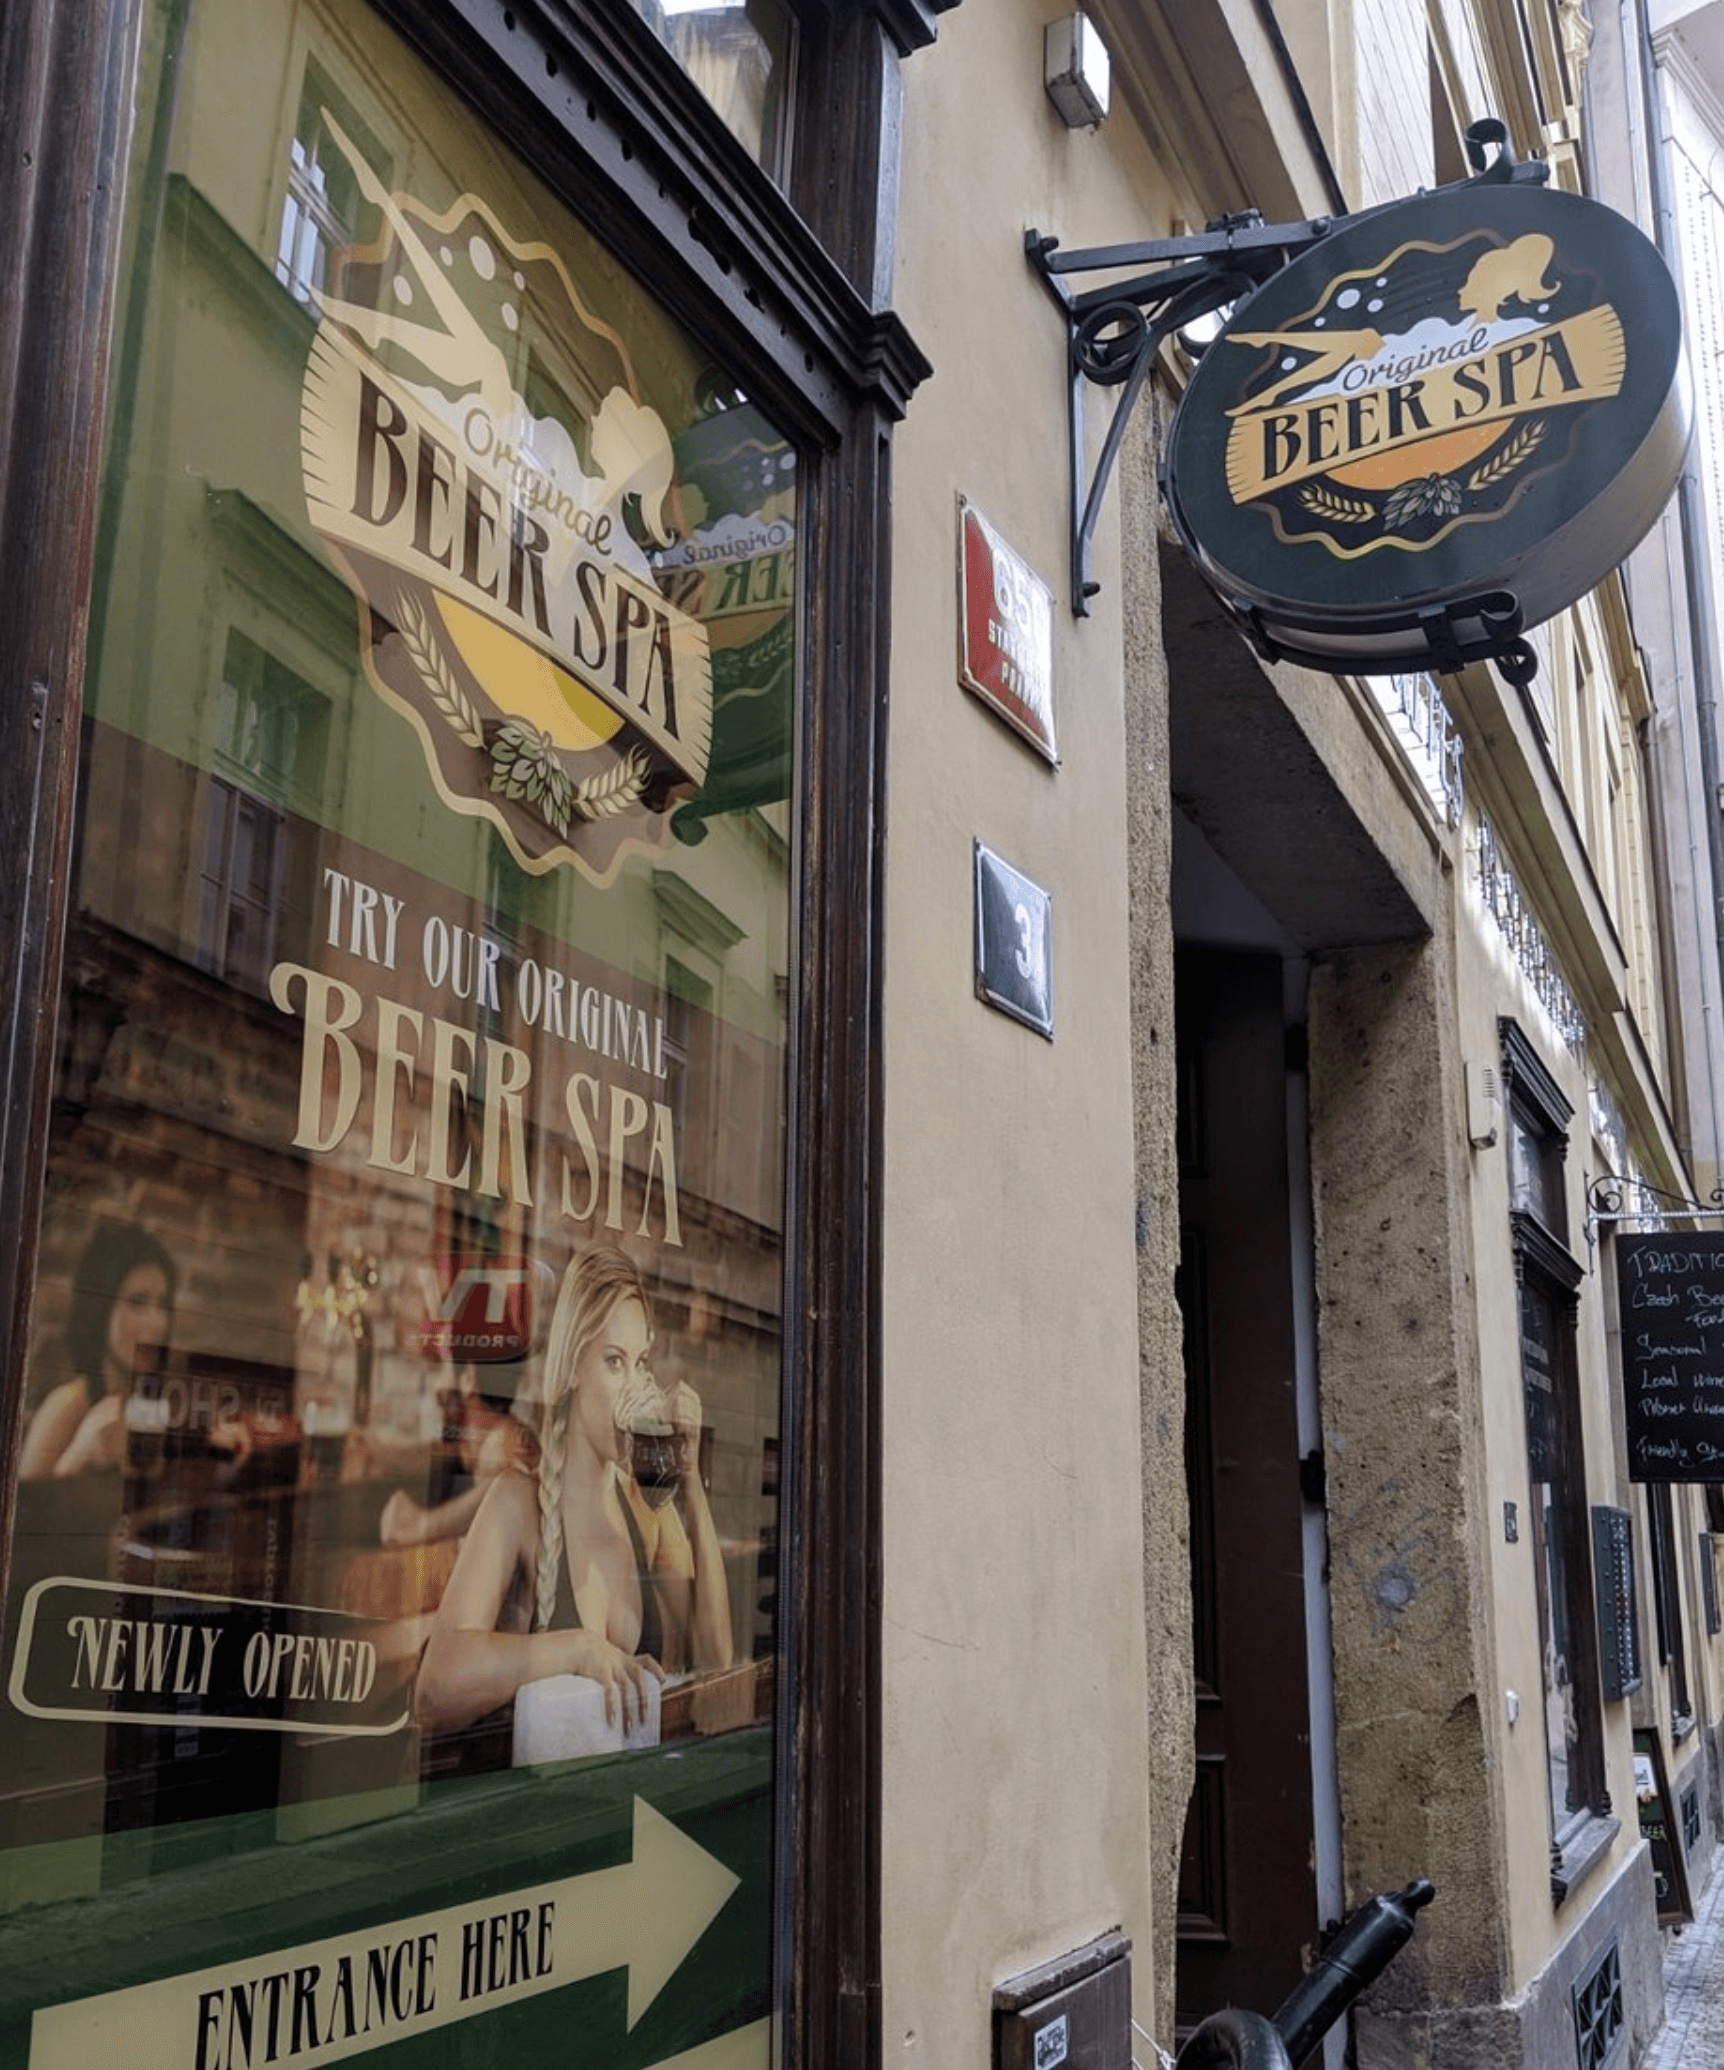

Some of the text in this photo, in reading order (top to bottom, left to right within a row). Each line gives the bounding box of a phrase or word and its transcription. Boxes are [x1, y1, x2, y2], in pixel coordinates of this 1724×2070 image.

[1262, 330, 1584, 481] BEER SPA
[1342, 327, 1489, 392] Original
[350, 370, 681, 742] BEER SPA
[464, 407, 613, 556] Original
[323, 868, 669, 1080] TRY OUR ORIGINAL
[1014, 902, 1032, 980] 3
[269, 961, 684, 1248] BEER SPA
[66, 1615, 376, 1704] NEWLY OPENED
[194, 1900, 556, 2070] ENTRANCE HERE
